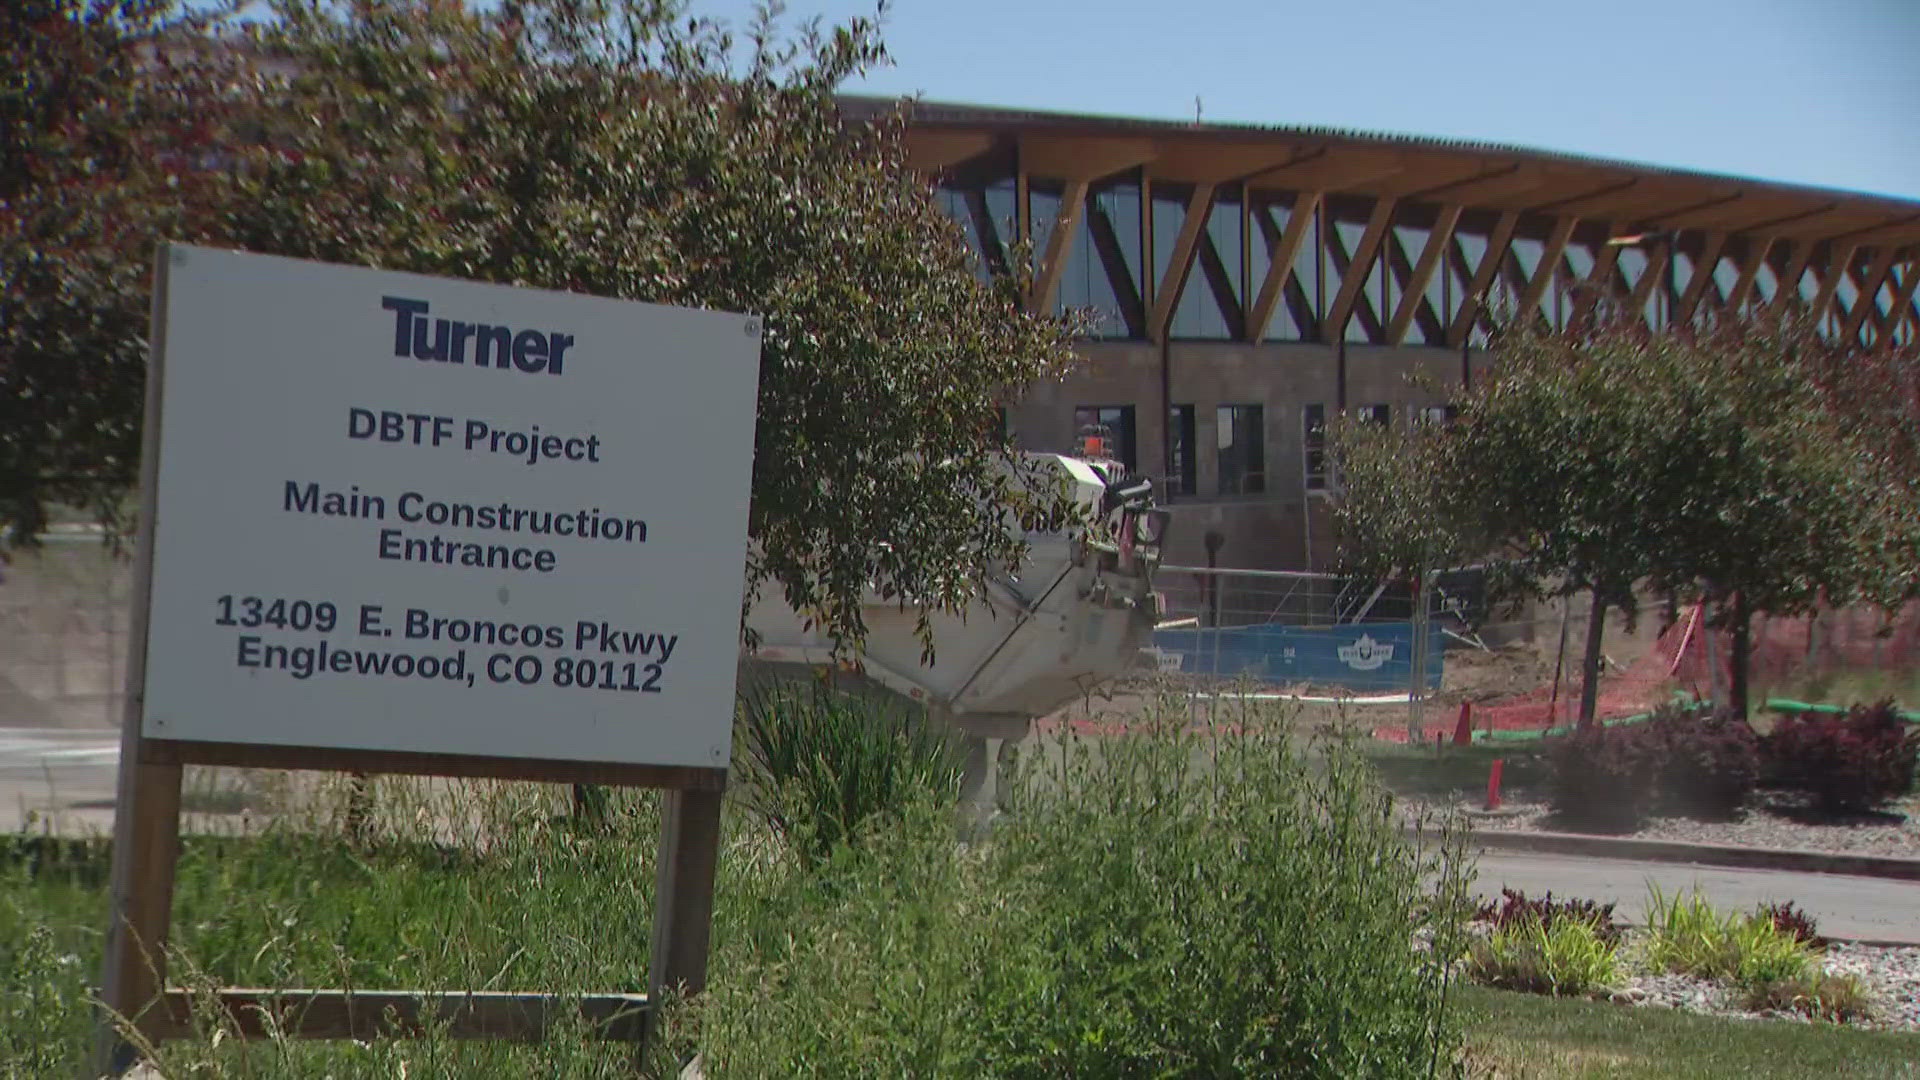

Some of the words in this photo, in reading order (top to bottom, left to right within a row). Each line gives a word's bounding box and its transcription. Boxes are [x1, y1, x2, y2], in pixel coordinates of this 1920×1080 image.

[382, 296, 574, 376] Turner
[348, 408, 454, 447] DBTF
[465, 419, 600, 465] Project
[284, 480, 384, 520] Main
[398, 492, 647, 543] Construction
[379, 528, 555, 572] Entrance
[216, 595, 337, 632] 13409
[359, 605, 392, 638] E.
[405, 609, 563, 648] Broncos
[576, 621, 678, 665] Pkwy
[238, 636, 475, 688] Englewood,
[487, 653, 542, 686] CO
[553, 657, 662, 693] 80112
